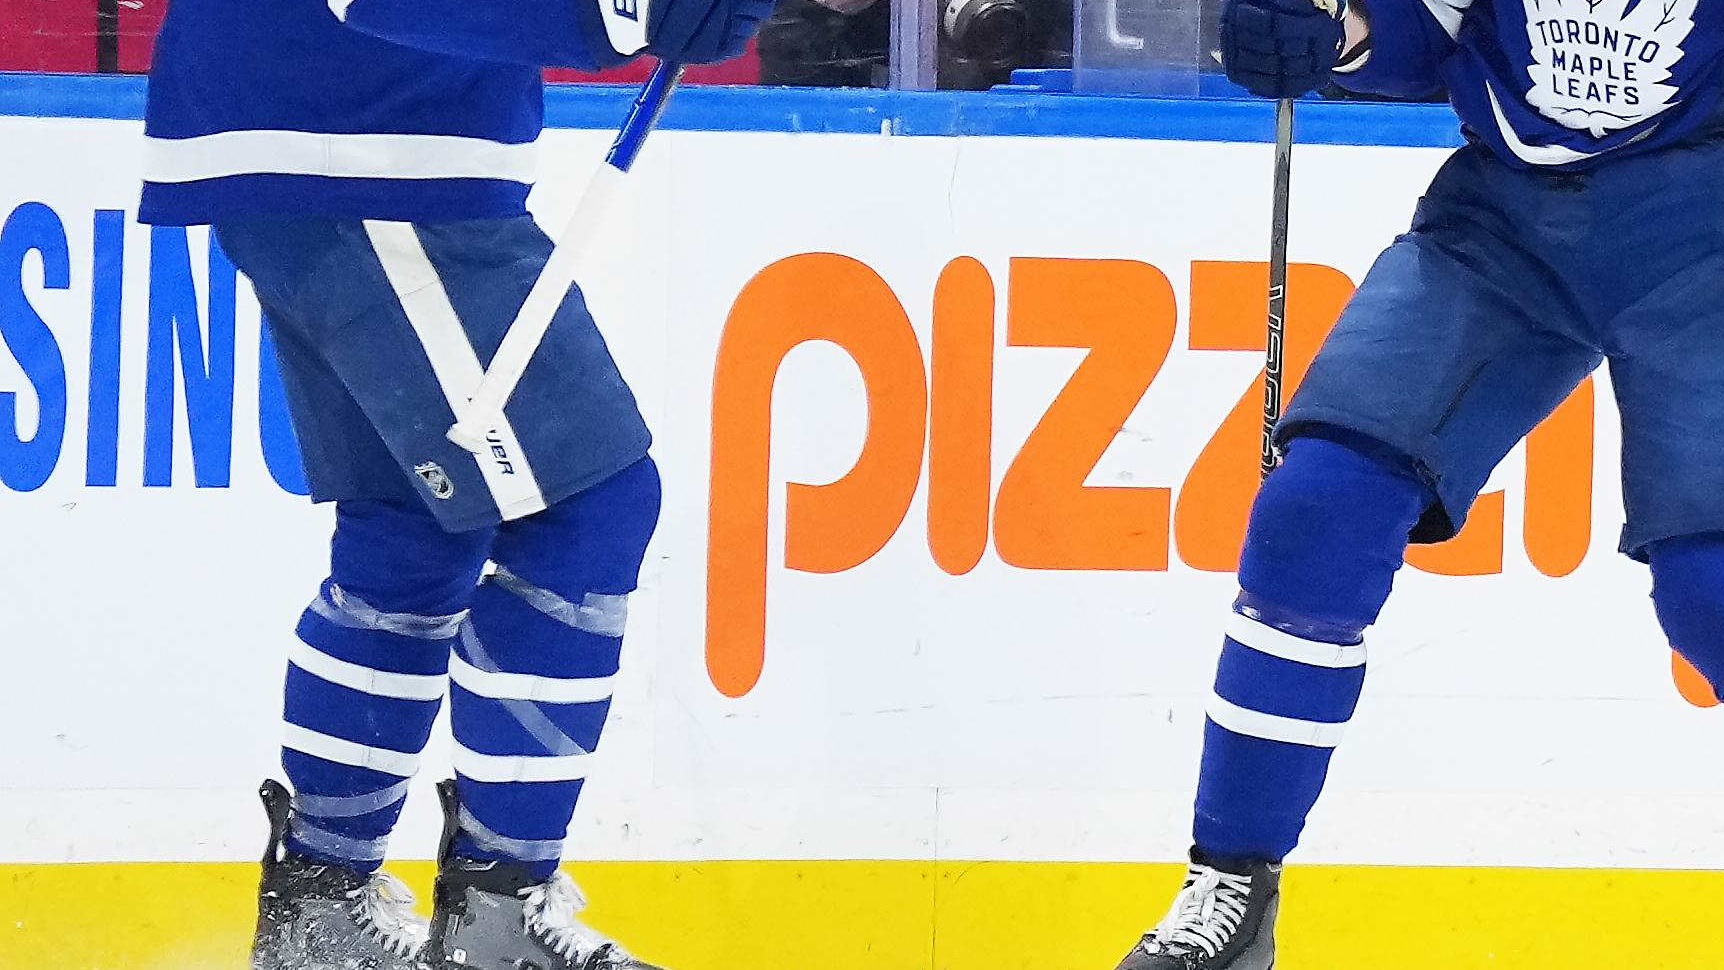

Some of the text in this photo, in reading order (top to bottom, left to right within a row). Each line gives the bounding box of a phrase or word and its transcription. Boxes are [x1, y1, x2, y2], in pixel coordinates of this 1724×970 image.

[1535, 18, 1661, 64] TORONTO
[1551, 47, 1638, 82] MAPLE
[1551, 73, 1640, 105] LEAFS
